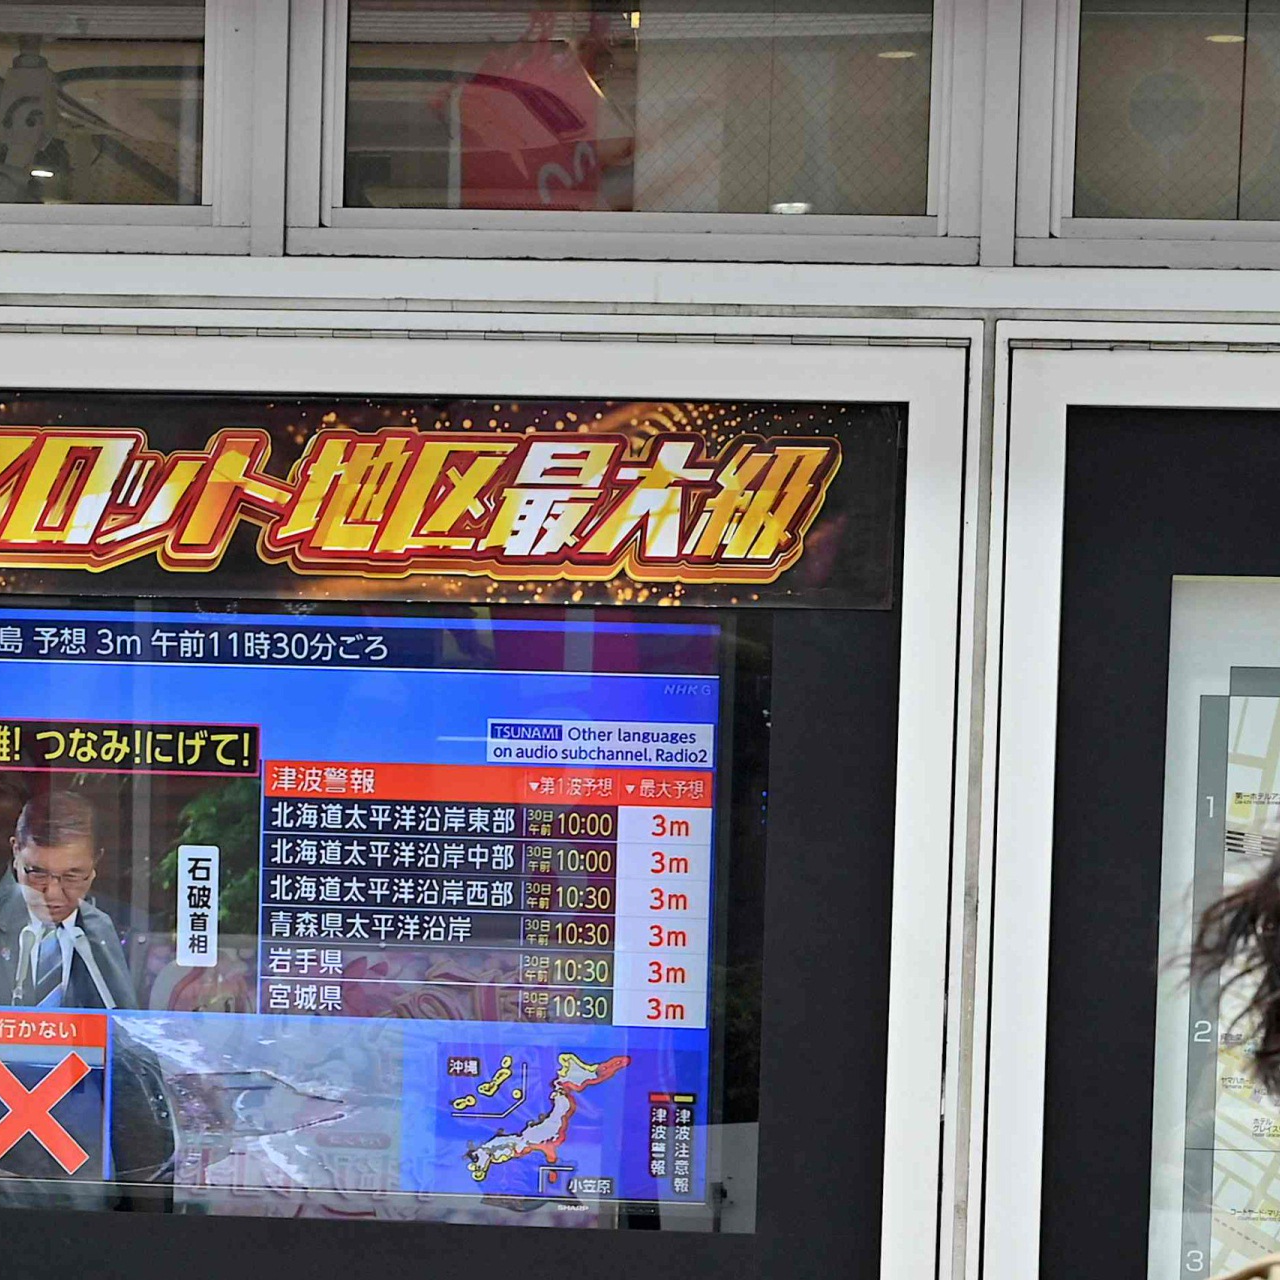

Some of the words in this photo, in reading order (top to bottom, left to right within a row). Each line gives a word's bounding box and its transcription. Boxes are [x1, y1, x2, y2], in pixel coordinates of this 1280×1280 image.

[33, 627, 87, 656] 予想
[97, 629, 141, 656] 3m
[150, 630, 389, 661] 午前11時30分ごろ
[664, 684, 698, 696] NHK
[701, 685, 712, 696] G
[494, 725, 560, 740] TSUNAMI
[568, 727, 613, 742] Other
[617, 728, 697, 744] languages
[37, 730, 250, 767] つなみ!にげて!
[493, 747, 512, 758] on
[516, 745, 558, 760] audio
[656, 748, 708, 763] Radio2
[271, 768, 376, 794] 津波警報
[540, 776, 613, 797] 第1波予想
[639, 779, 704, 798] 最大予想
[527, 809, 554, 822] 30日
[1206, 796, 1214, 818] 1
[270, 805, 515, 835] 北海道太平洋沿岸東部
[528, 823, 552, 836] 午前
[557, 812, 612, 837] 10:00
[651, 814, 690, 838] 3m
[270, 841, 514, 871] 北海道太平洋沿岸中部
[527, 846, 553, 859] 30日
[556, 847, 612, 873] 10:00
[650, 851, 689, 875] 3m
[528, 860, 551, 873] 午前
[269, 877, 513, 907] 北海道太平洋沿岸西部
[526, 882, 552, 895] 30日
[556, 885, 611, 910] 10:30
[649, 887, 688, 911] 3m
[186, 856, 213, 956] 石破首相
[527, 897, 551, 910] 午前
[268, 912, 472, 942] 青森県太平洋沿岸
[525, 919, 551, 932] 30日
[555, 922, 610, 947] 10:30
[649, 925, 687, 948] 3m
[525, 933, 549, 946] 午前
[268, 947, 344, 975] 岩手県
[524, 956, 550, 968] 30日
[554, 958, 609, 984] 10:30
[525, 969, 548, 983] 午前
[647, 961, 686, 985] 3m
[268, 983, 343, 1012] 宮城県
[523, 992, 549, 1005] 30日
[553, 995, 608, 1020] 10:30
[524, 1005, 547, 1019] 午前
[646, 998, 685, 1021] 3m
[1193, 1020, 1212, 1042] 2
[449, 1059, 479, 1075] 沖縄
[651, 1107, 667, 1175] 津波警報
[673, 1108, 691, 1193] 津波注意報
[568, 1179, 611, 1194] 小笠原
[557, 1204, 589, 1212] SHARP
[1185, 1250, 1204, 1272] 3
